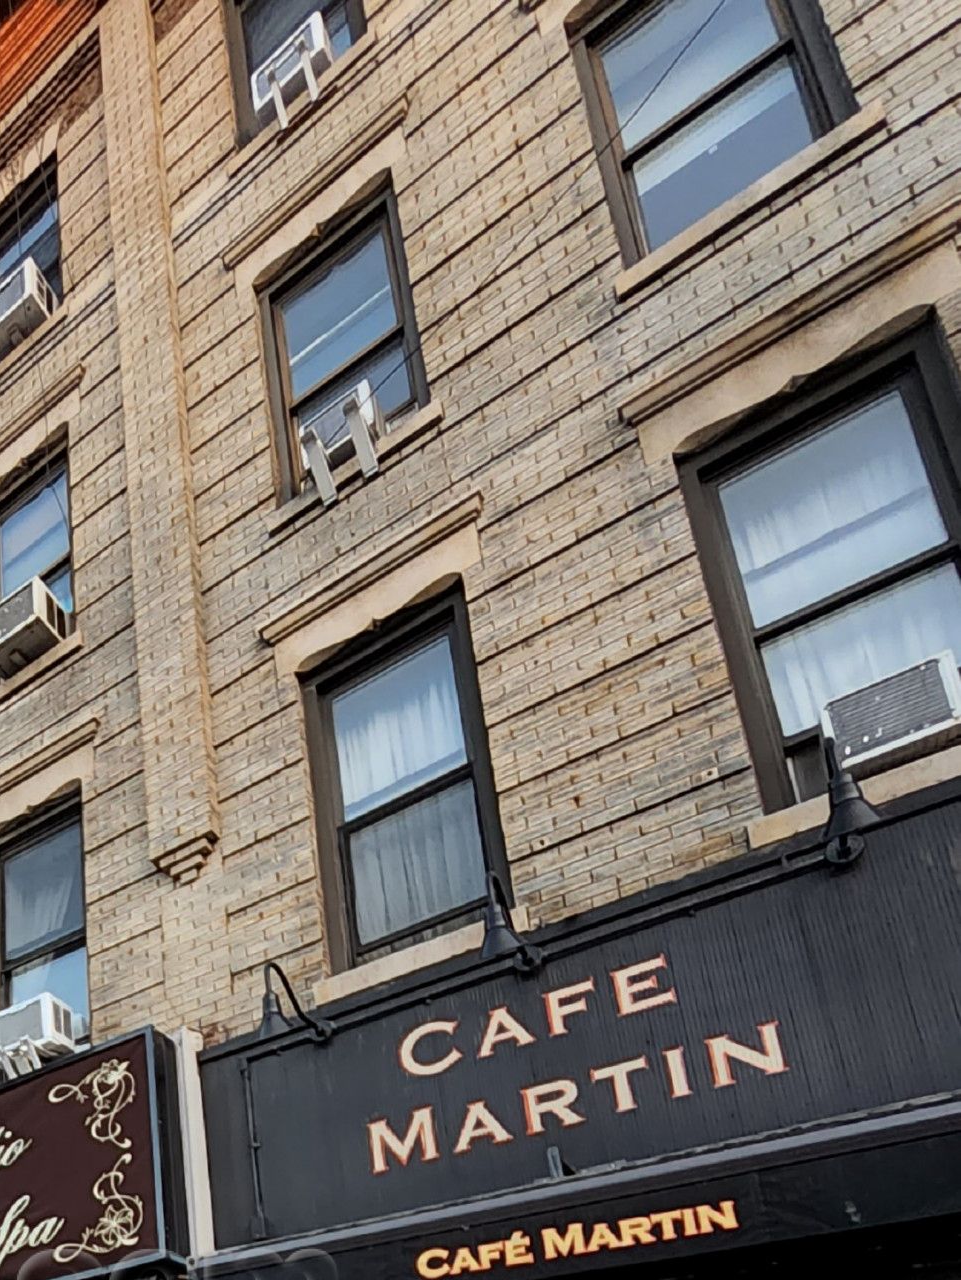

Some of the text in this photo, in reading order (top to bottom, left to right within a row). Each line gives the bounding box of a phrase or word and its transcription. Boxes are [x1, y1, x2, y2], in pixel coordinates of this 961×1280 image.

[398, 952, 678, 1077] CAFE
[366, 1020, 790, 1175] MARTIN
[414, 1200, 740, 1280] CAFÉ MARTIN
